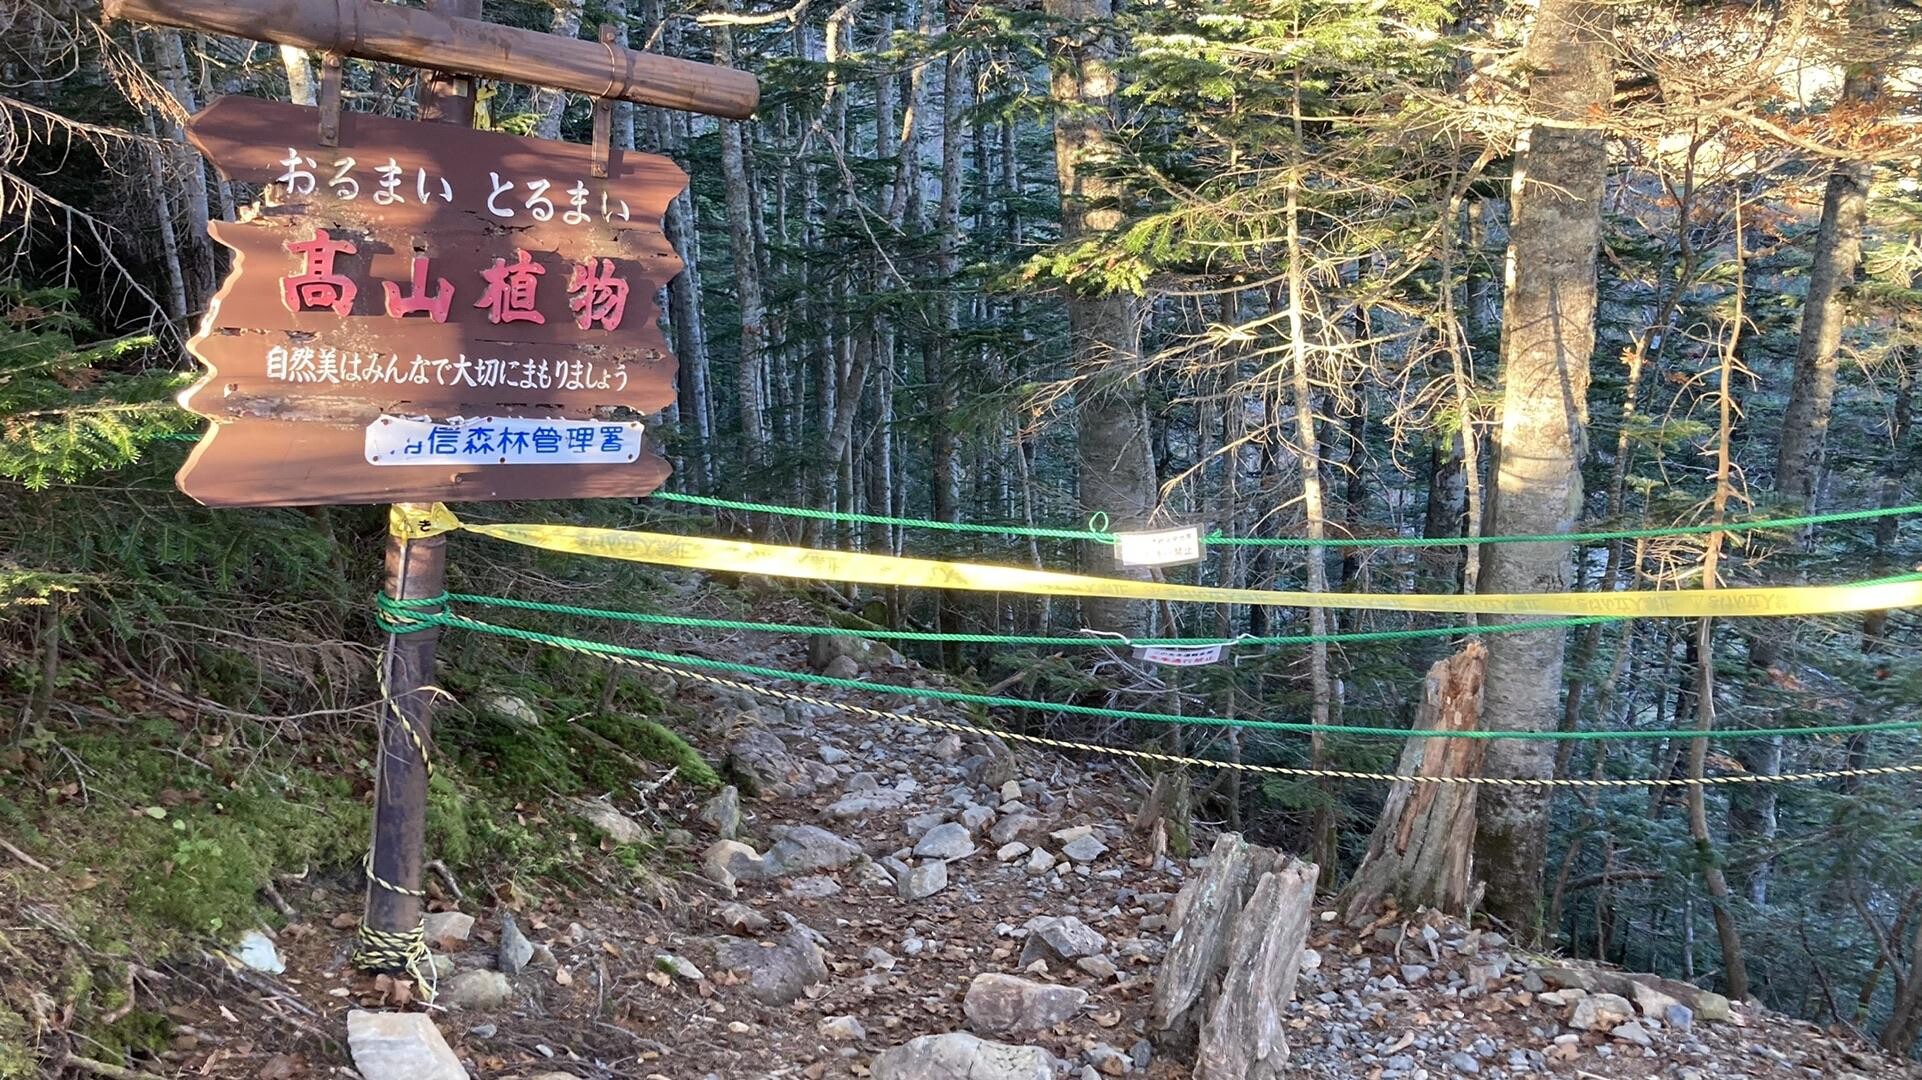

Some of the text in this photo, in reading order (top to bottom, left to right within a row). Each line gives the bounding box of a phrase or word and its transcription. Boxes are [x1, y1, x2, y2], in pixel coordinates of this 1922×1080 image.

[277, 147, 631, 225] おるまい とるまい
[266, 345, 628, 392] 自然美はみんなで大切にまもりましょう
